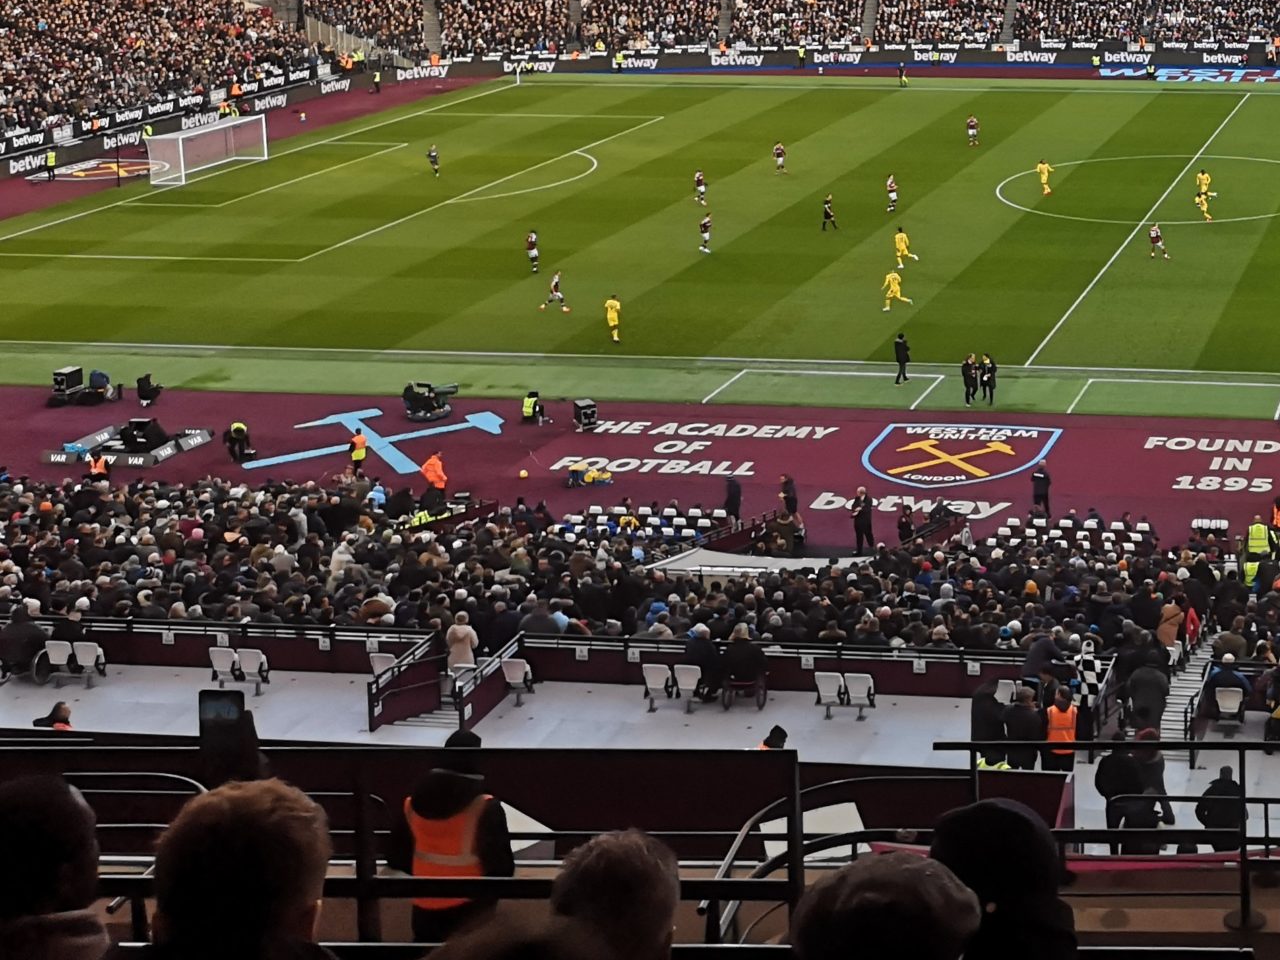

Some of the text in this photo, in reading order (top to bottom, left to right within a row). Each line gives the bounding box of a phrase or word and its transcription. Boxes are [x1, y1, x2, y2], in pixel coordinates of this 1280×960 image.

[1163, 41, 1188, 50] betway
[1194, 41, 1220, 50] betway
[1225, 42, 1250, 51] betway
[711, 52, 764, 66] betway
[1006, 51, 1057, 64] betway
[1104, 52, 1152, 64] betway
[1203, 52, 1241, 64] betwa
[396, 64, 448, 81] betway
[1099, 68, 1260, 77] WEST
[263, 76, 285, 88] betway
[320, 78, 350, 94] betway
[179, 94, 204, 108] betway
[254, 94, 288, 112] betway
[148, 101, 174, 115] betway
[116, 108, 143, 122] betway
[181, 110, 220, 130] betway
[82, 117, 110, 130] beay
[12, 132, 44, 148] betway
[9, 154, 46, 174] betwa
[95, 432, 110, 442] VAR
[648, 422, 840, 440] ACADEMY
[906, 426, 1039, 438] WEST HAM
[929, 433, 1007, 441] UNITED
[159, 446, 173, 457] VAR
[653, 440, 712, 454] OF
[50, 454, 68, 462] VAR
[128, 456, 144, 465] VAR
[1208, 456, 1252, 472] IN
[549, 456, 755, 476] FOOTBALL
[902, 473, 967, 482] LONDON
[1172, 475, 1273, 492] 1895
